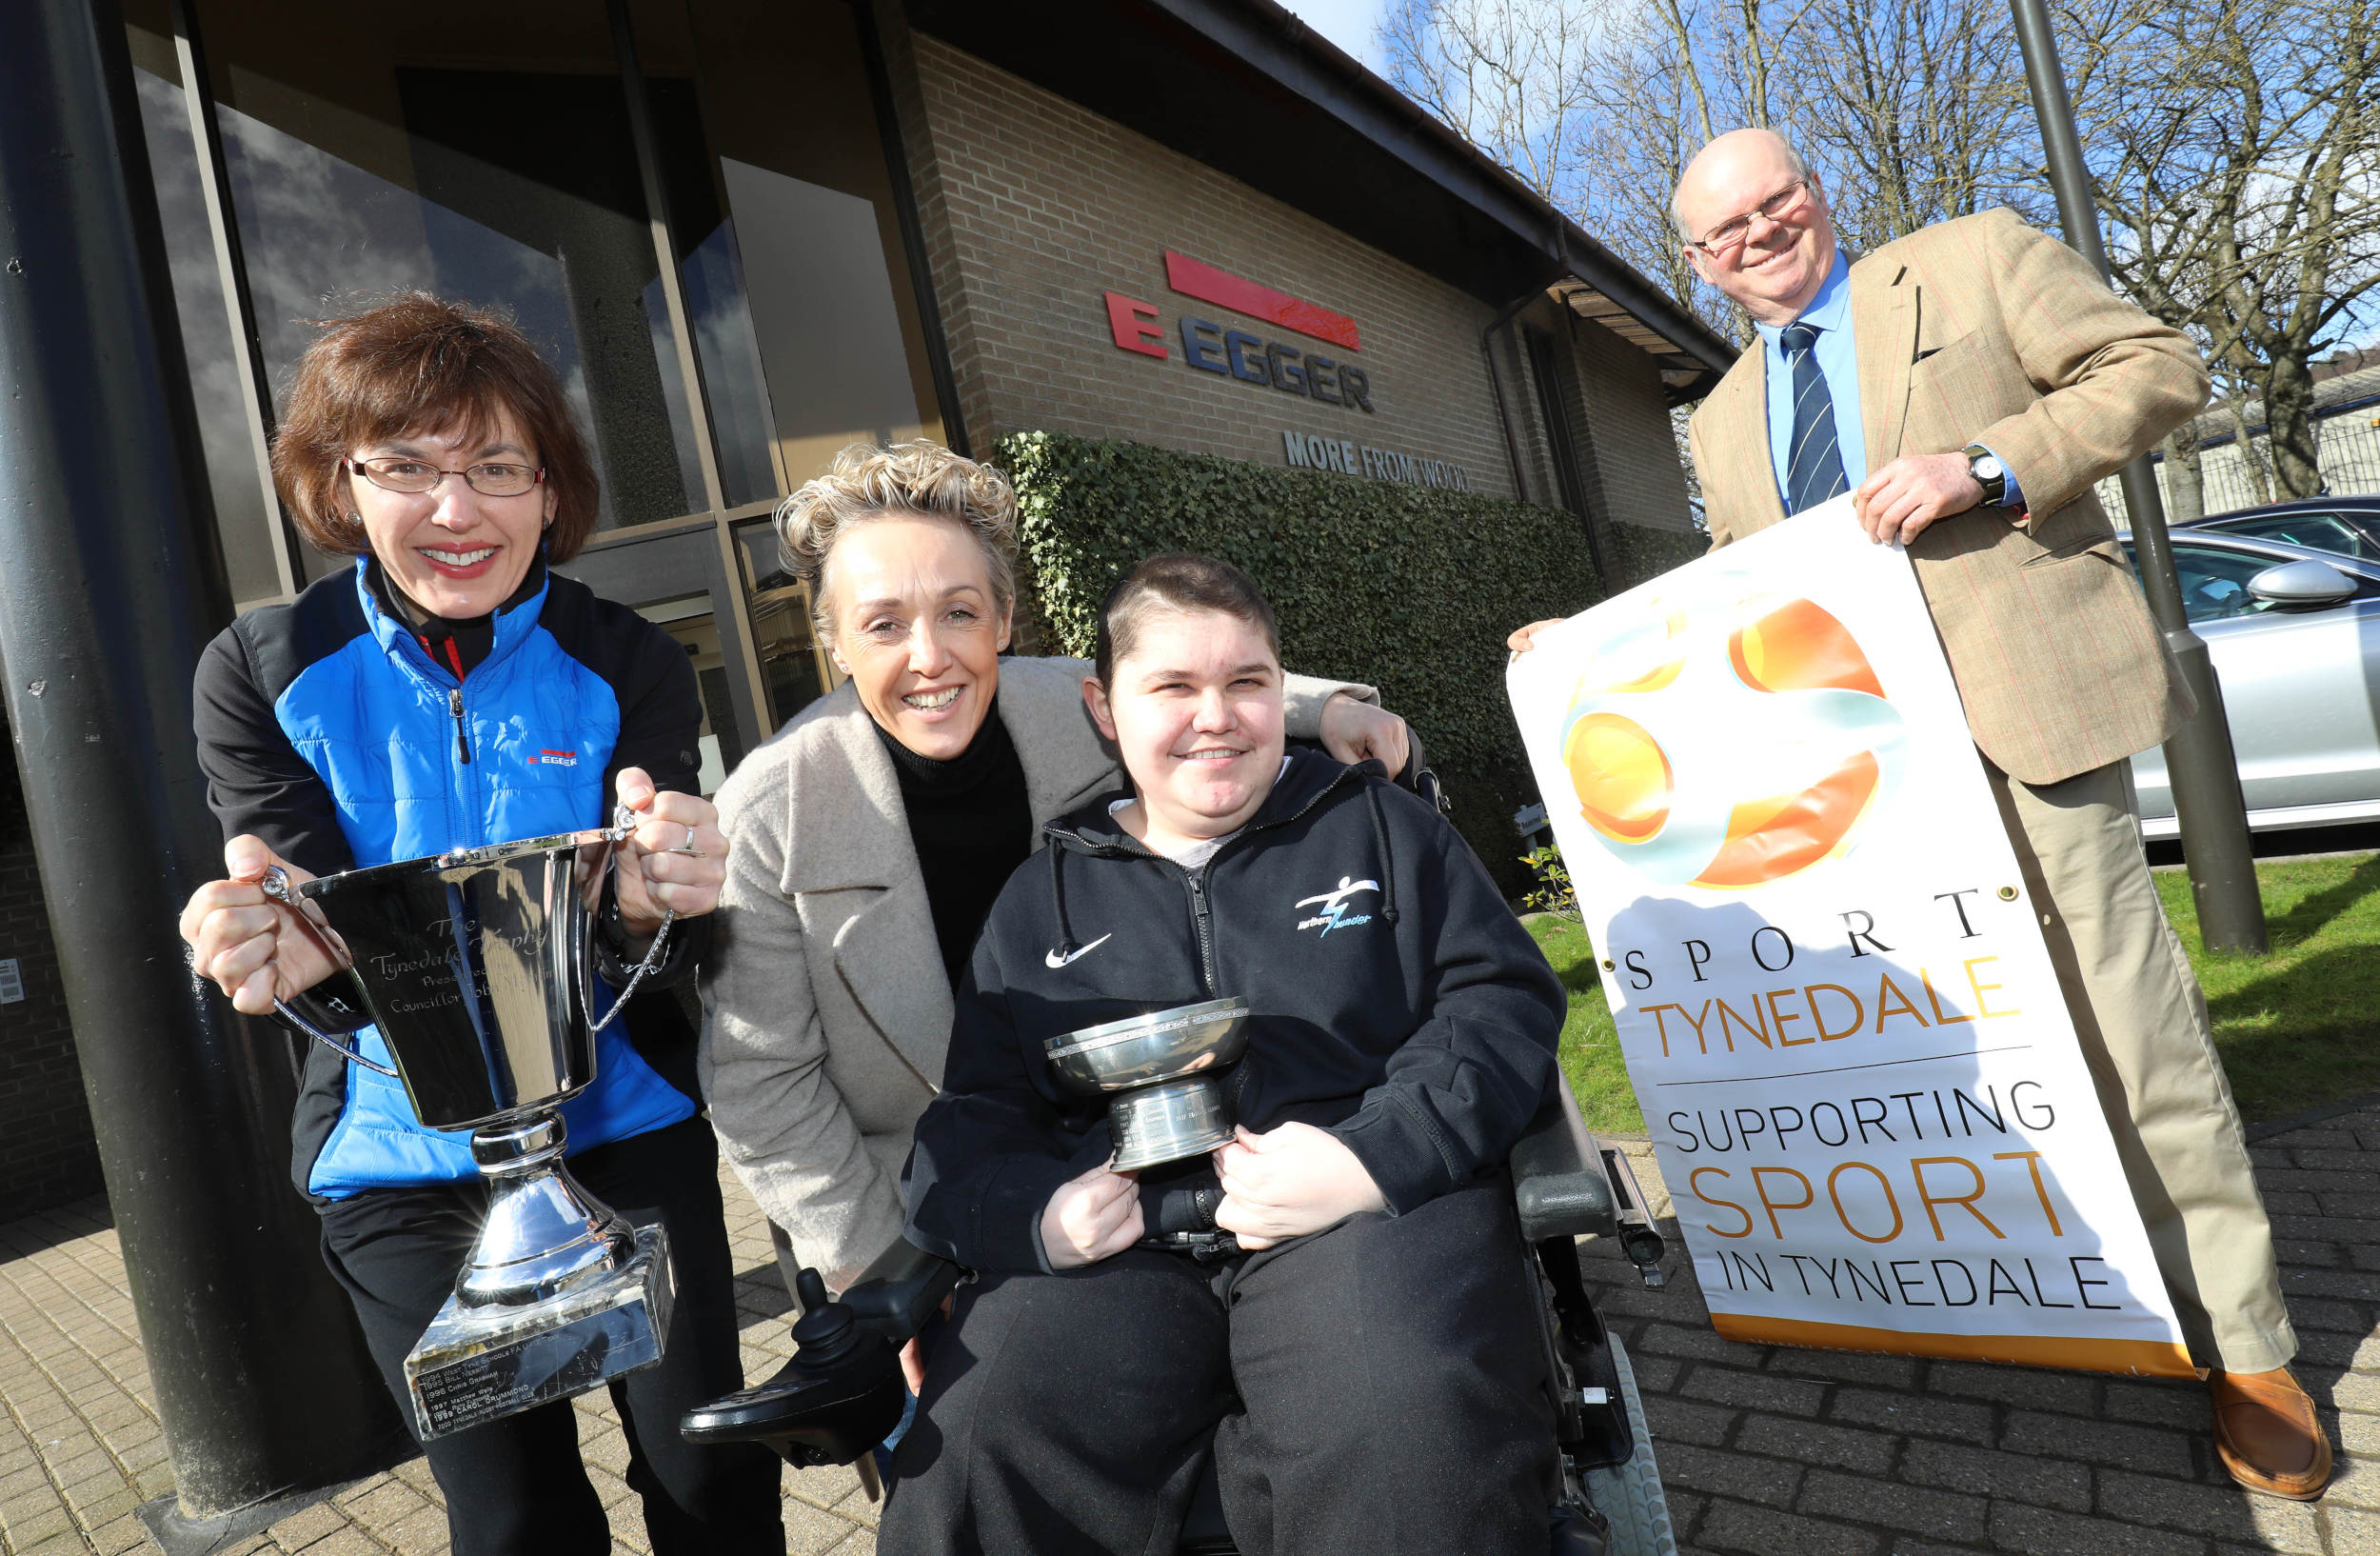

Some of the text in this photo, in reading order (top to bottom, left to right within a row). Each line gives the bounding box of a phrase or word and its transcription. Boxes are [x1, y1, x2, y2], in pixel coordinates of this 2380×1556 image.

[1105, 290, 1377, 413] E EGGER
[1284, 430, 1359, 475] MORE
[1359, 445, 1418, 485] FROM
[541, 756, 578, 767] EGGER
[426, 912, 476, 938] The
[1297, 916, 1333, 930] Northern
[1625, 888, 1983, 990] SPORT
[369, 945, 462, 982] Tynedale
[390, 992, 463, 1013] Councillor
[1639, 956, 2021, 1057] TYNEDALE
[1668, 1081, 2055, 1153] SUPPORTING
[1689, 1150, 2064, 1244] SPORT
[1716, 1250, 2122, 1310] IN TYNEDALE
[427, 1388, 446, 1400] 1996
[457, 1403, 483, 1414] CAROL
[486, 1385, 529, 1405] DRUMMOND
